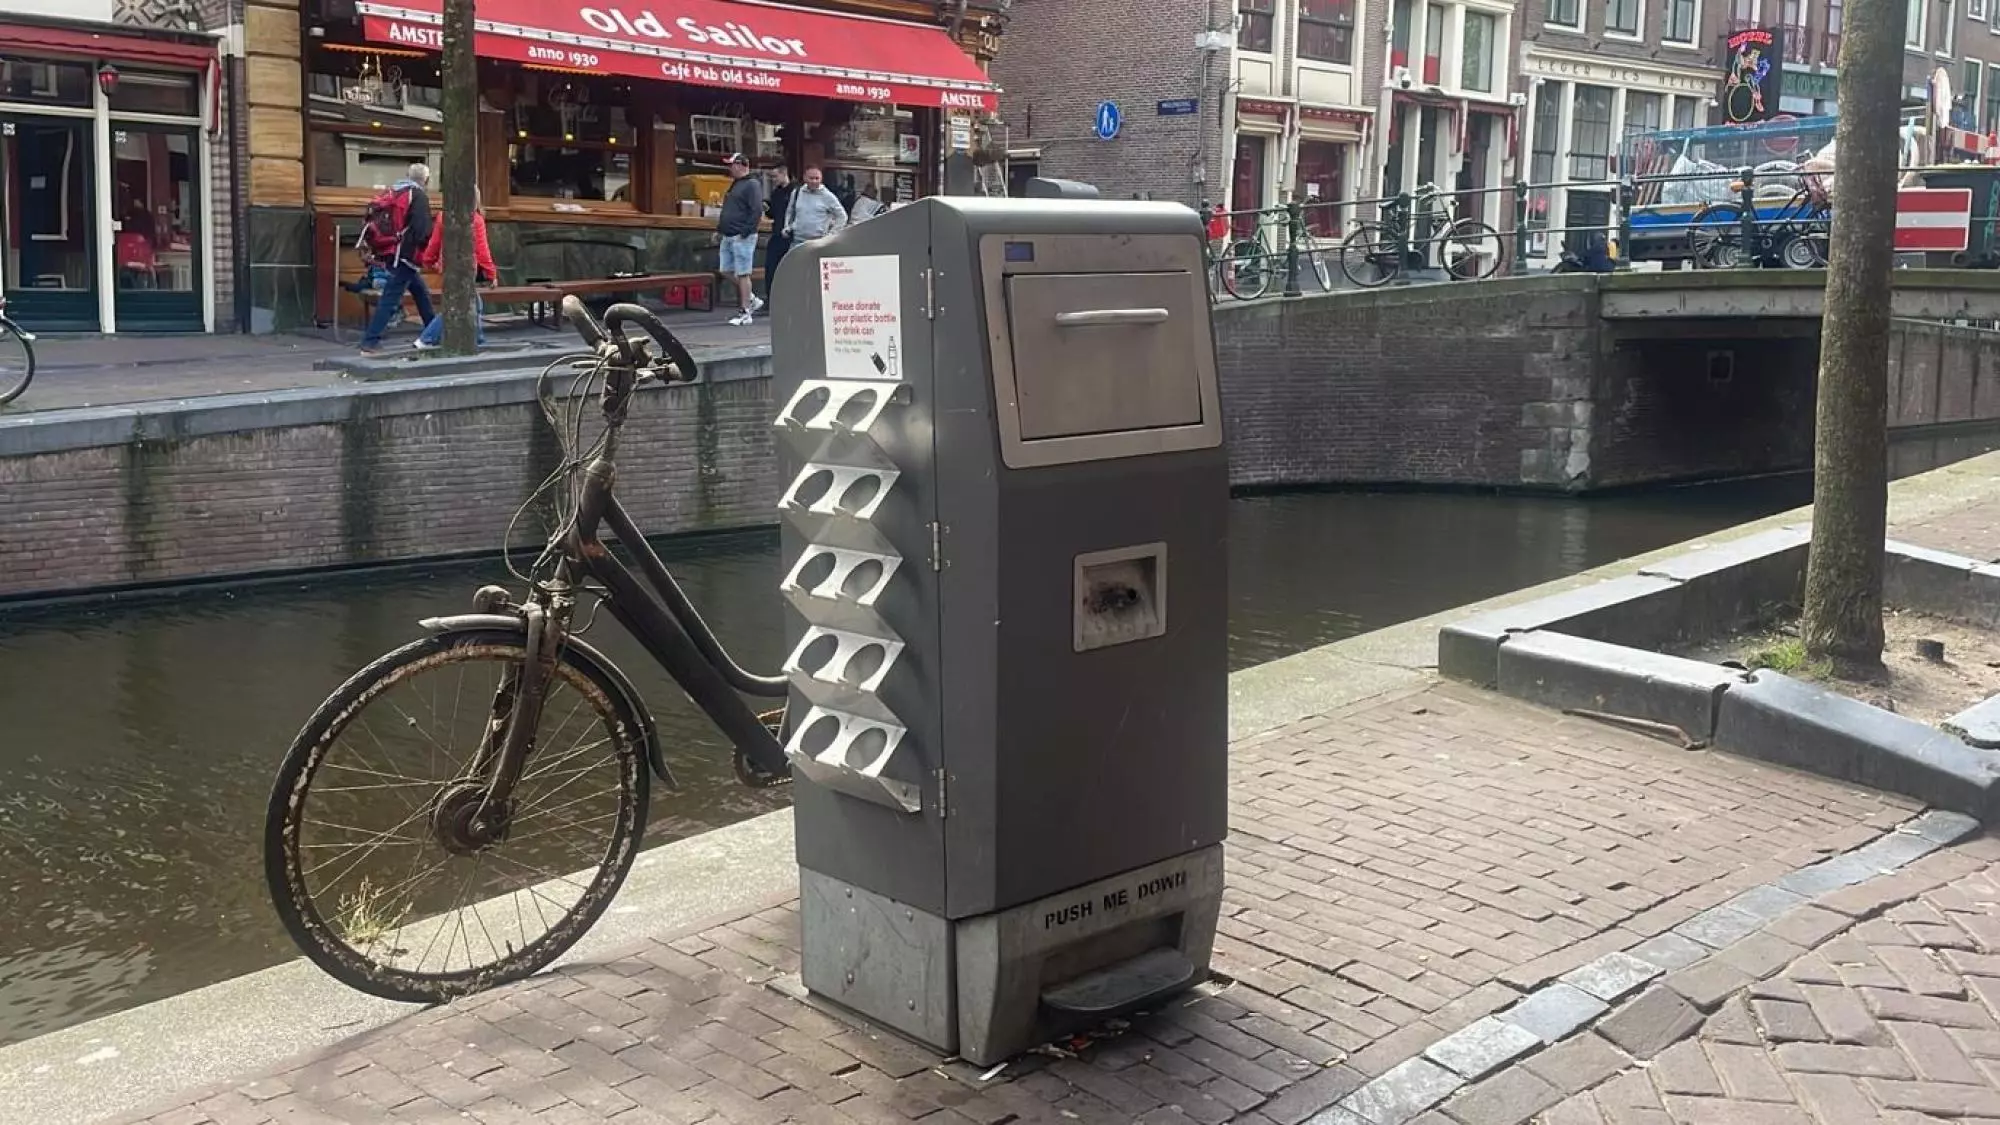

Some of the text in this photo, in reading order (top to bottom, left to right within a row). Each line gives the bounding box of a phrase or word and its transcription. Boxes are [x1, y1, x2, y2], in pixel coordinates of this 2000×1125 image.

[390, 22, 444, 47] AMSTE
[580, 8, 807, 57] Old Sailor
[528, 46, 598, 66] anno 1930
[661, 62, 781, 88] Café Pub Old Sailor
[836, 83, 891, 99] anno 1930
[941, 91, 984, 107] AMSTEL
[832, 301, 881, 311] Please donate
[833, 313, 897, 325] your plastic bottle
[834, 326, 874, 336] or drink can
[1045, 871, 1187, 929] PUSH ME DOWN
